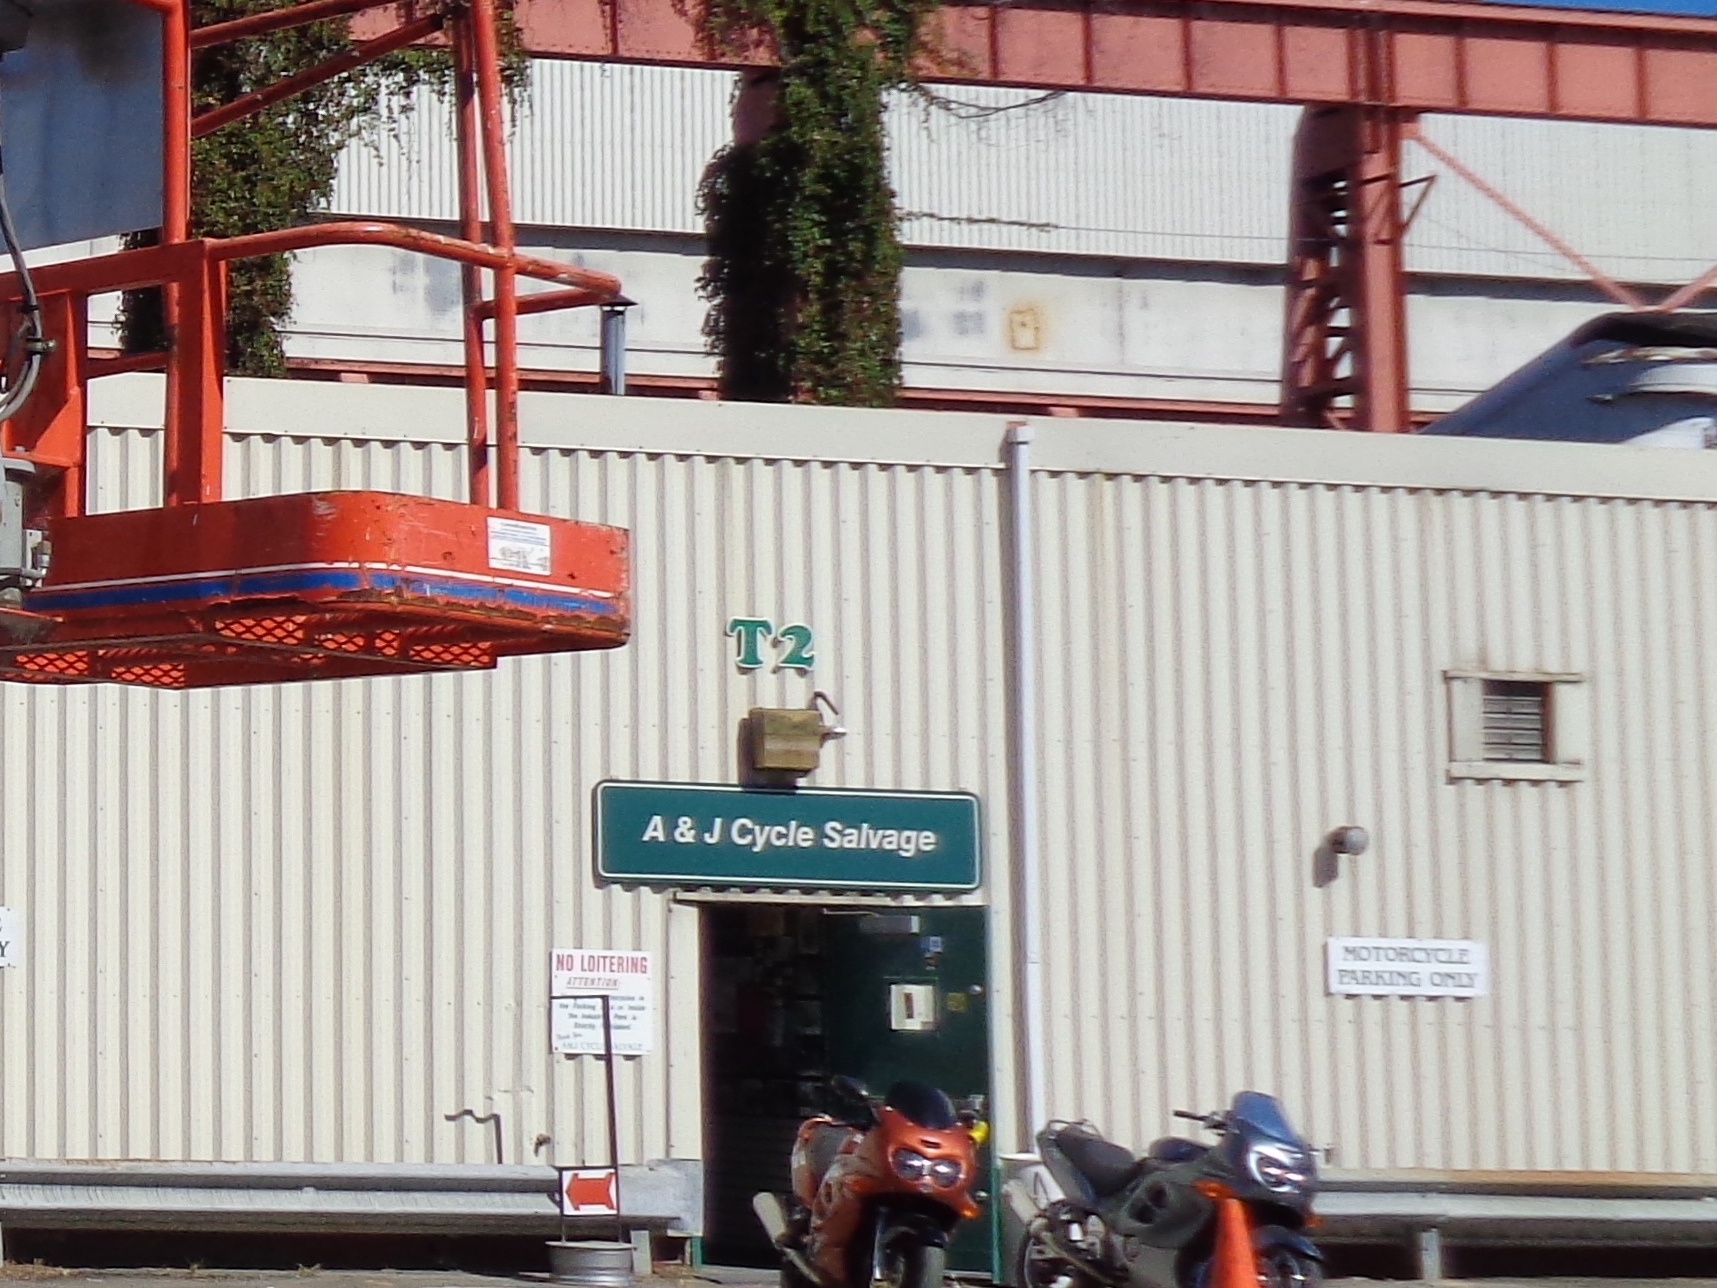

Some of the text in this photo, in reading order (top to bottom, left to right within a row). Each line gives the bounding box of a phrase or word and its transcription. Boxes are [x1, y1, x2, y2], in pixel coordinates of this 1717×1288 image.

[727, 616, 817, 671] T2
[642, 815, 938, 858] A & J Cycle Salvage
[555, 953, 648, 974] NO LOITERING
[1342, 946, 1472, 965] MOTORCYCLE
[1337, 968, 1480, 989] PARKING ONLY
